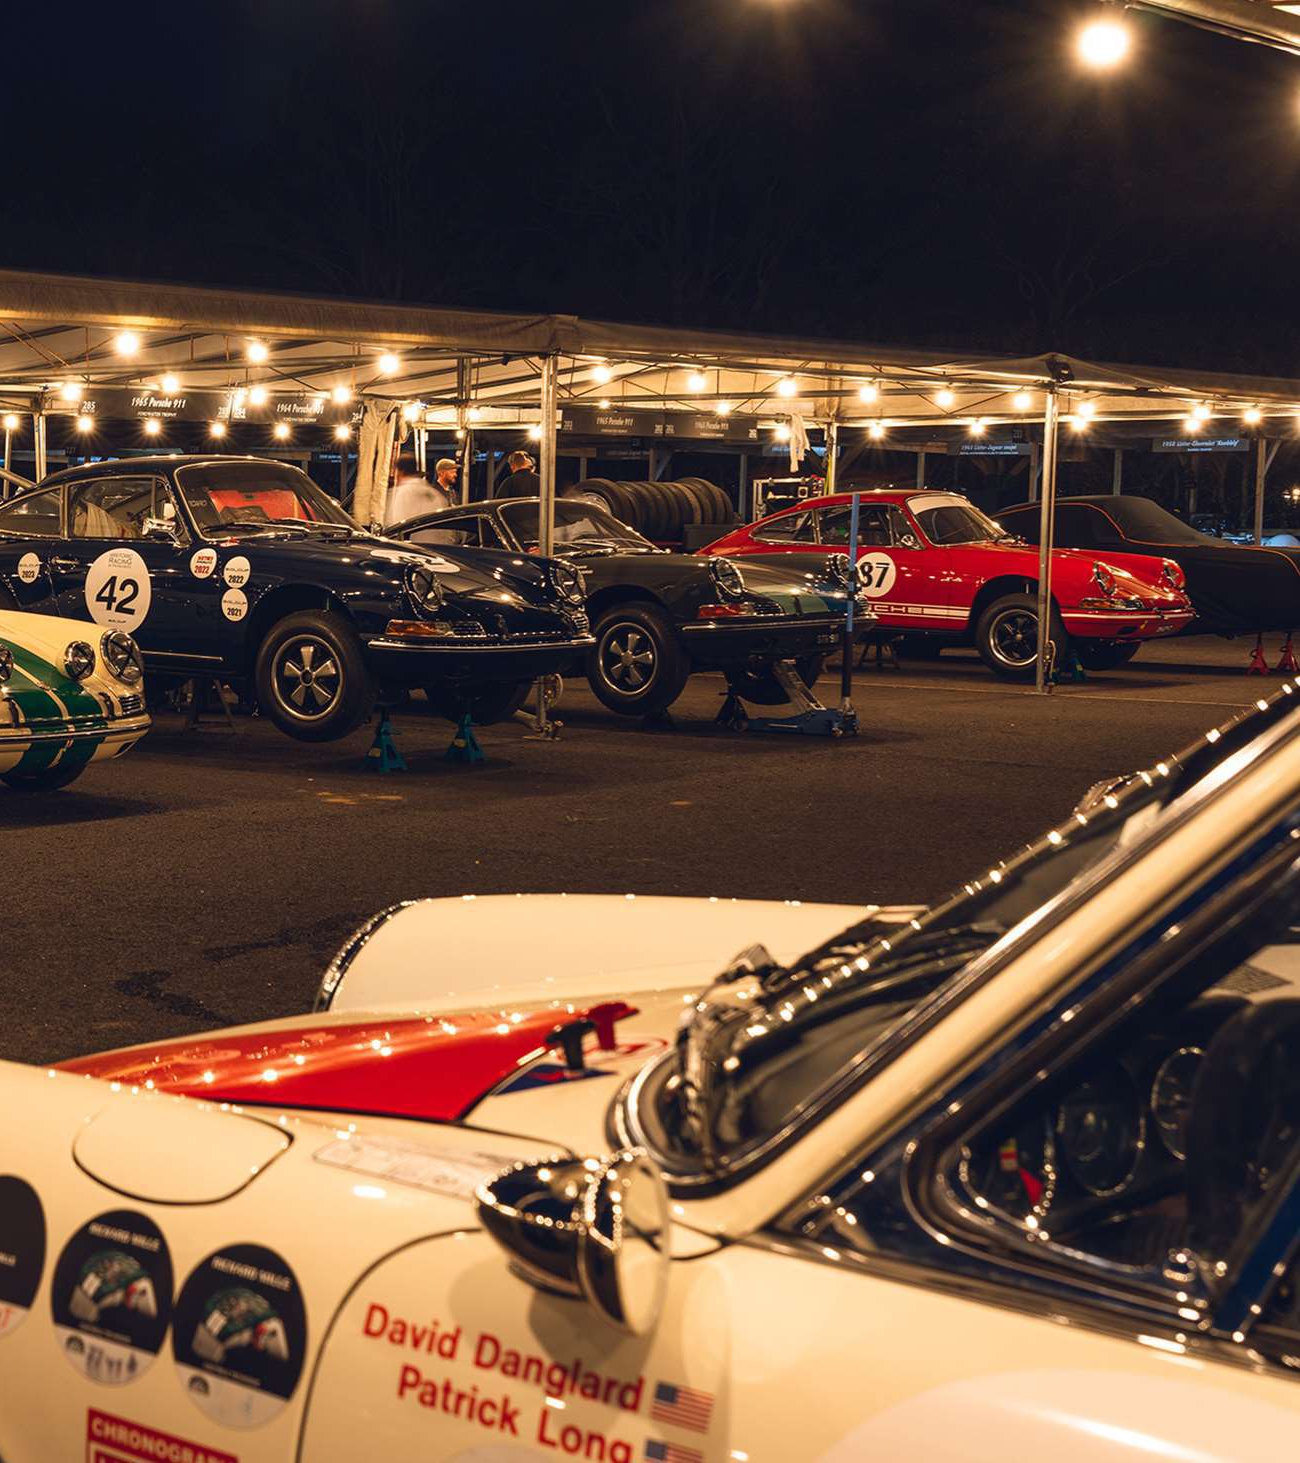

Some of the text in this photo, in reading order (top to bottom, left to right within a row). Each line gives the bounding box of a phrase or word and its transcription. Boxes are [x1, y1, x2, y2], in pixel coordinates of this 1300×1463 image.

[83, 401, 95, 410] 285
[131, 397, 186, 409] 1965 Porsche 911
[194, 565, 209, 574] 2022
[228, 575, 244, 584] 2022
[95, 575, 139, 616] 42
[227, 607, 242, 617] 2021
[363, 1302, 646, 1413] David Danglard
[397, 1363, 635, 1463] Patrick Long
